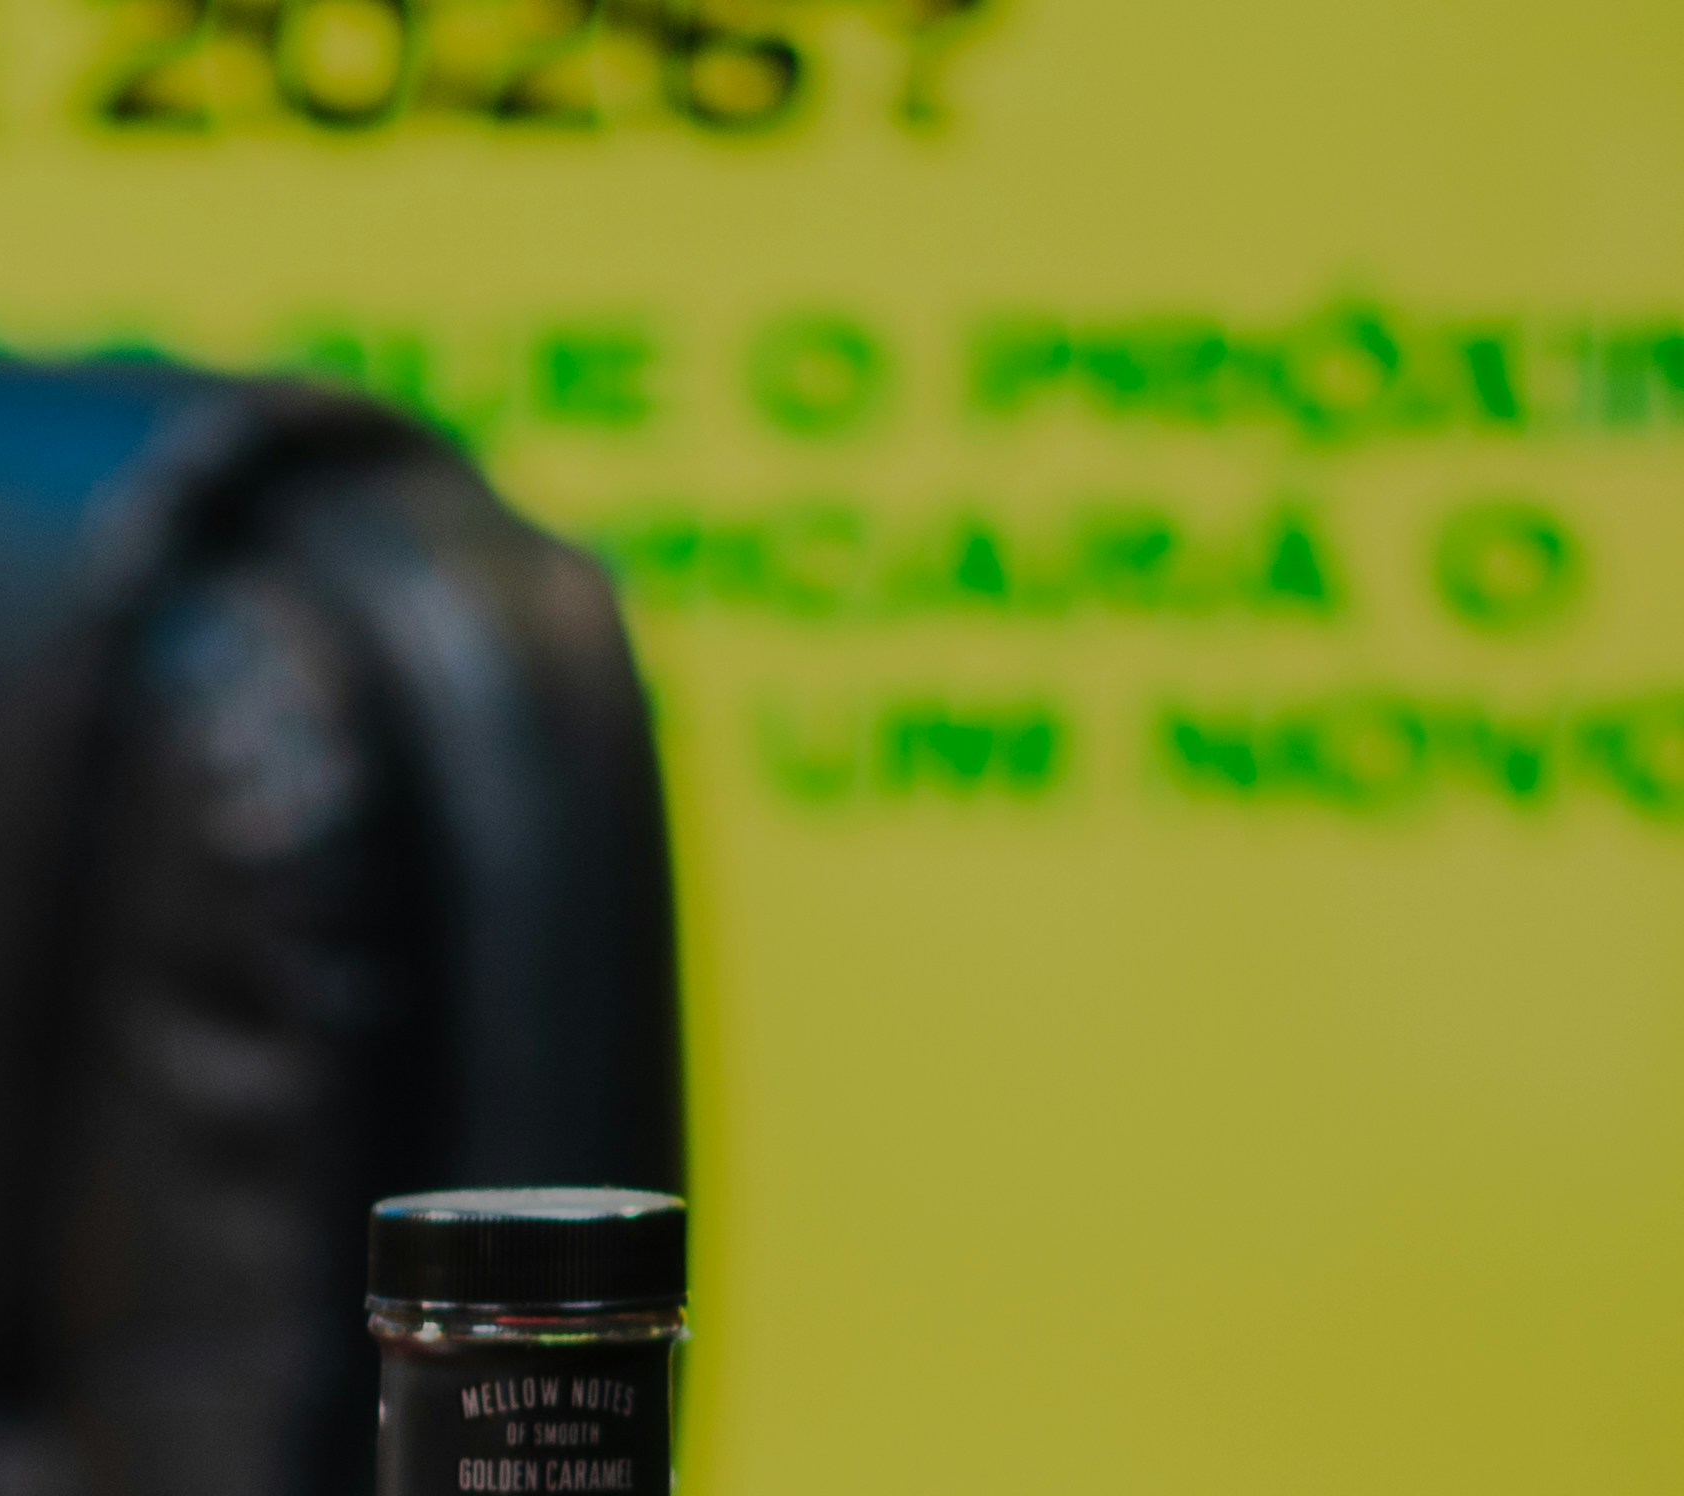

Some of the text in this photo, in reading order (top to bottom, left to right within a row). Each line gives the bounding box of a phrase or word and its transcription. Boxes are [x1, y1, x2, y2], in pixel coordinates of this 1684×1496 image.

[744, 316, 878, 440] O
[1434, 500, 1581, 632] O
[462, 1377, 634, 1419] MELLOW NOTES
[507, 1421, 599, 1446] OF SMOOTH
[459, 1458, 633, 1491] GOLDEN CARAMEL
